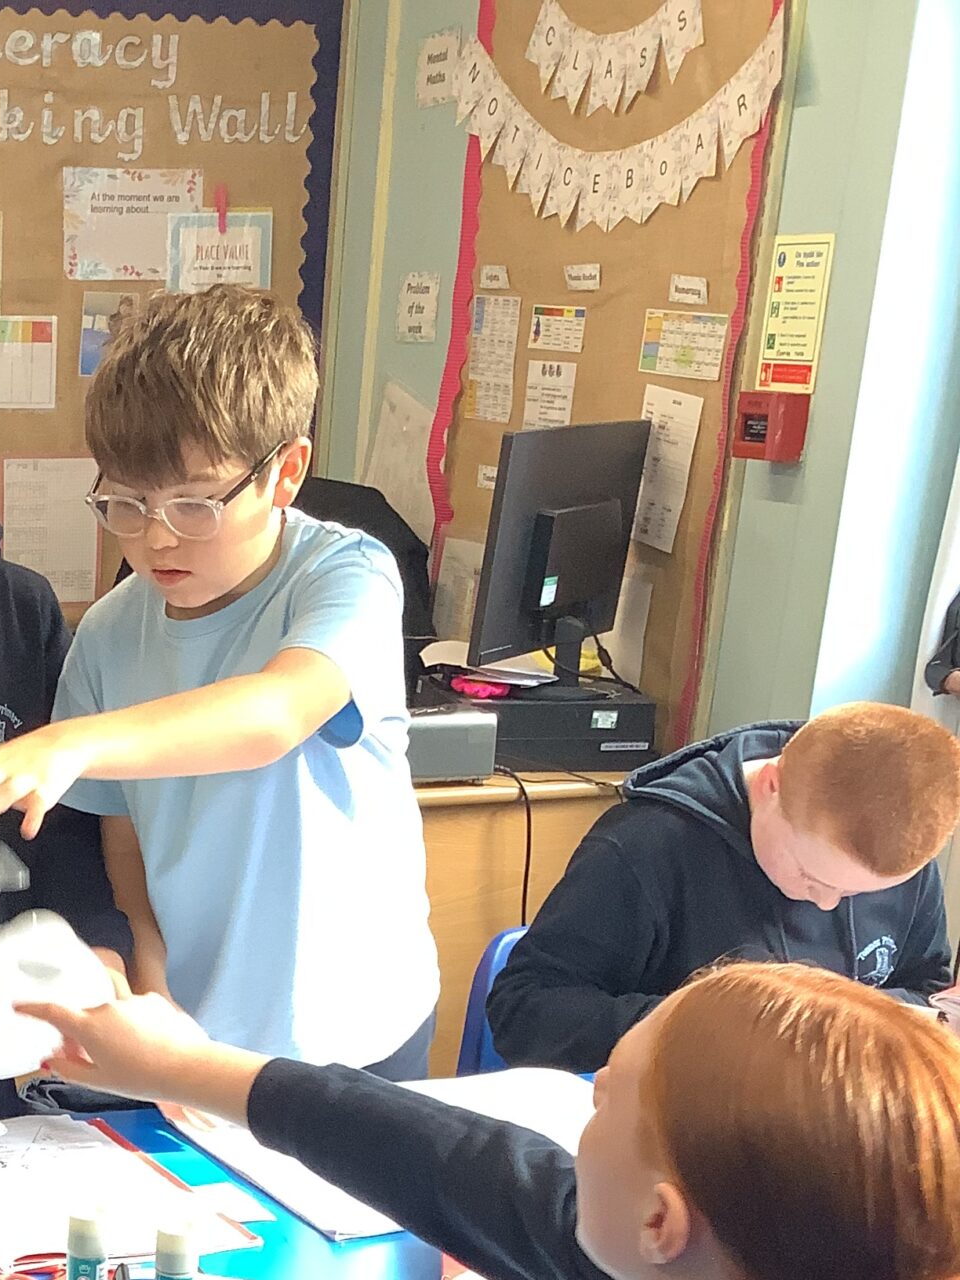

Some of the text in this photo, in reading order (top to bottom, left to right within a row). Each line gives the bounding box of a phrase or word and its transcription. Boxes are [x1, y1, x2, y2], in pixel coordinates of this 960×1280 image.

[427, 47, 448, 65] Mental
[167, 91, 308, 144] Wall
[91, 191, 180, 202] At the moment we are
[90, 204, 124, 215] learning
[195, 244, 249, 261] PLACE VALUE
[406, 282, 430, 295] Problem
[408, 302, 425, 317] of the
[408, 323, 422, 334] week
